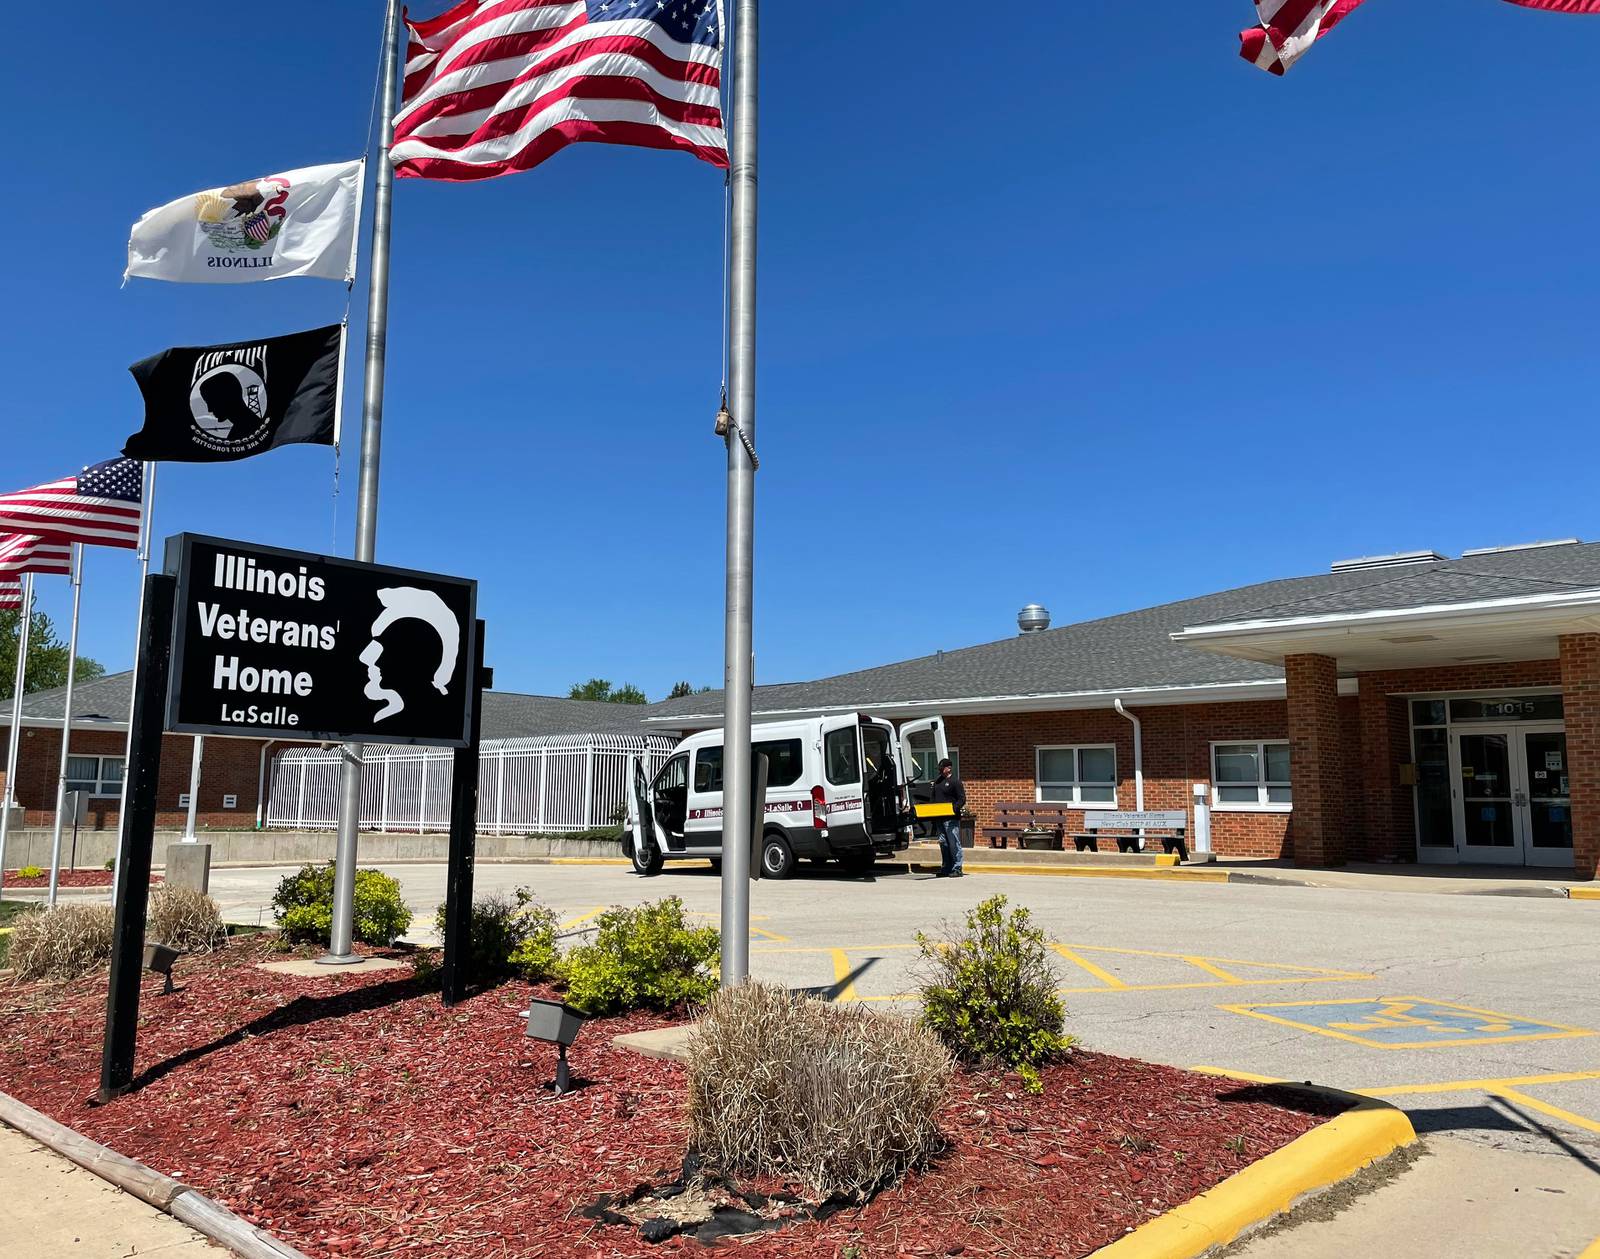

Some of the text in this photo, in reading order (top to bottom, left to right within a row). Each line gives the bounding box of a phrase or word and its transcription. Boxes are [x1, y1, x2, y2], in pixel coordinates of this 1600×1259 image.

[213, 553, 326, 601] Illinois
[197, 601, 341, 651] Veterans'
[212, 654, 313, 697] Home
[220, 703, 300, 726] LaSalle
[1496, 702, 1535, 714] 1015
